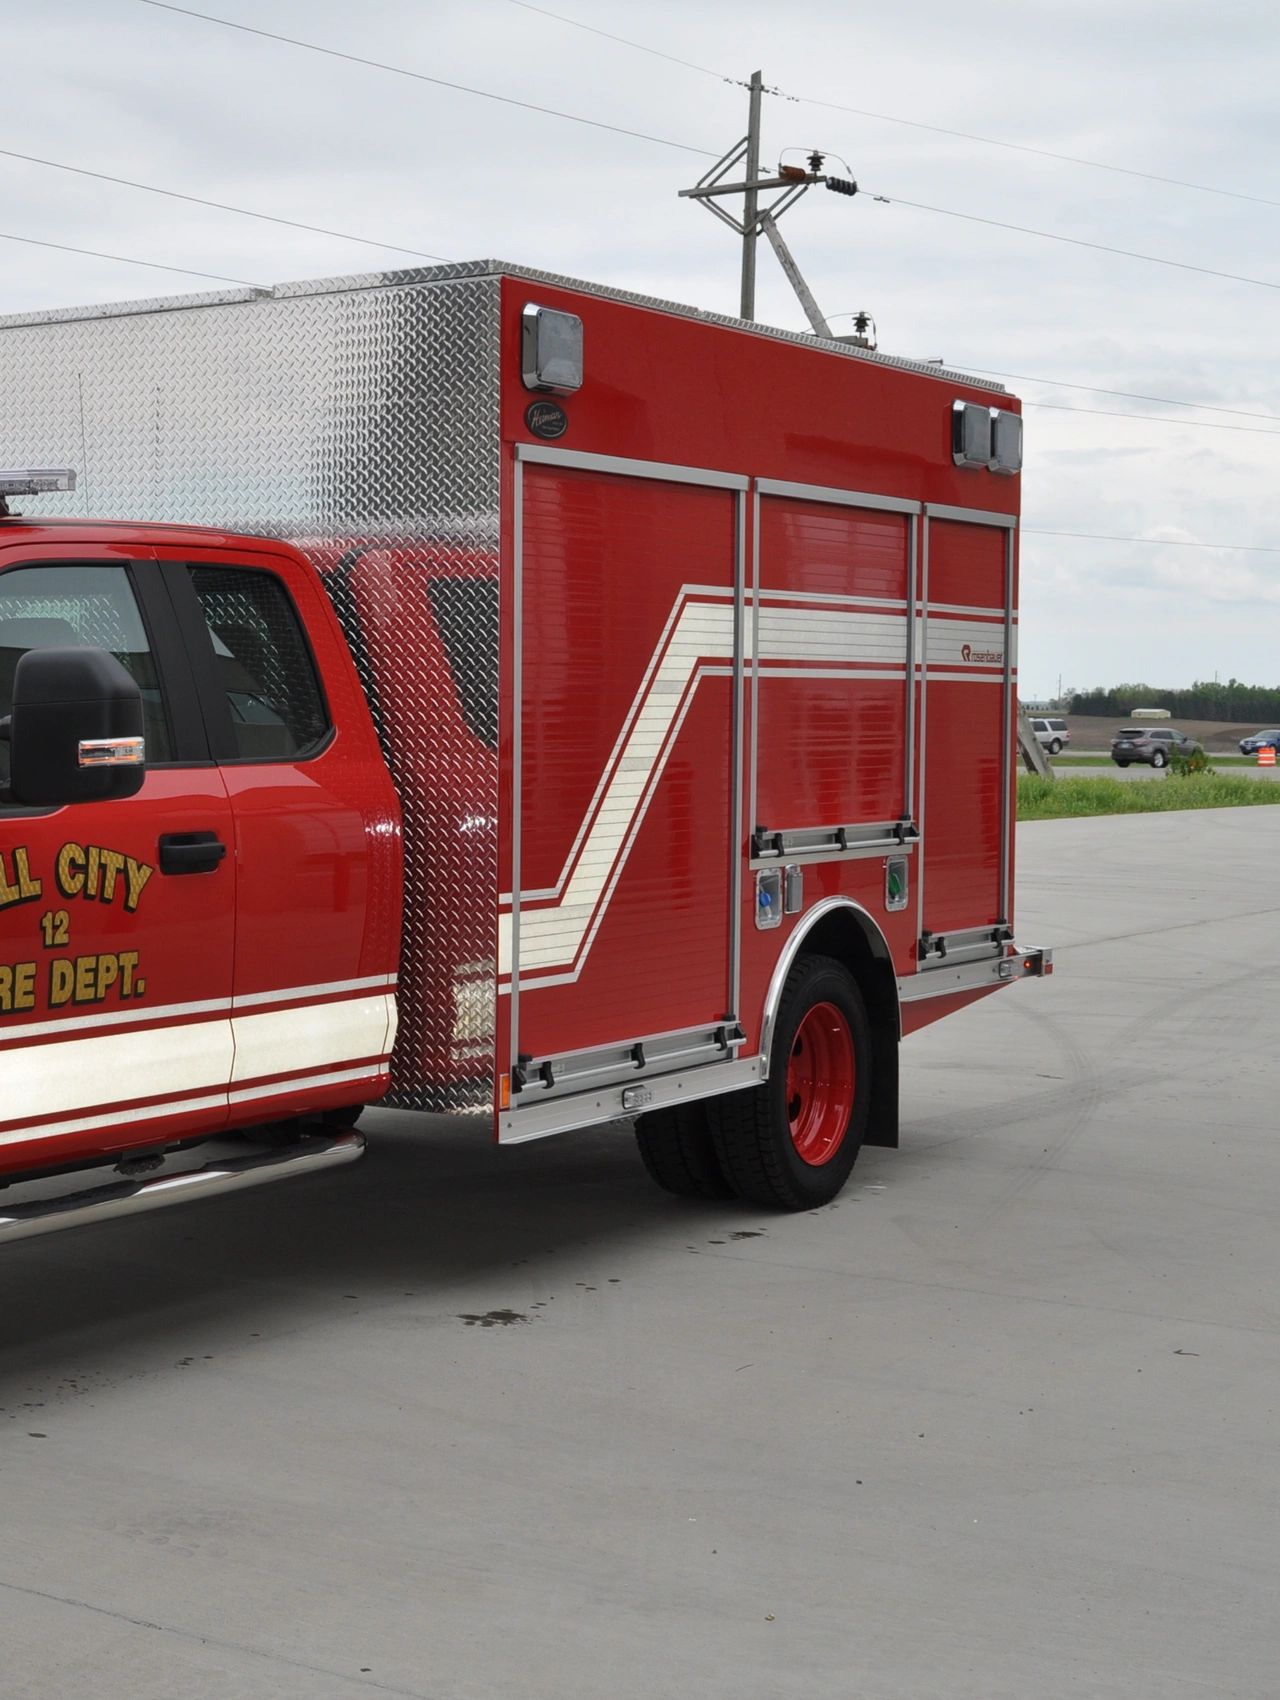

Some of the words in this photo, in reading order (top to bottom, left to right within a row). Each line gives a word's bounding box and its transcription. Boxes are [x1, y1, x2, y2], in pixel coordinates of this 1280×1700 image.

[55, 842, 155, 913] CITY
[40, 909, 70, 949] 12
[47, 950, 146, 1009] DEPT.
